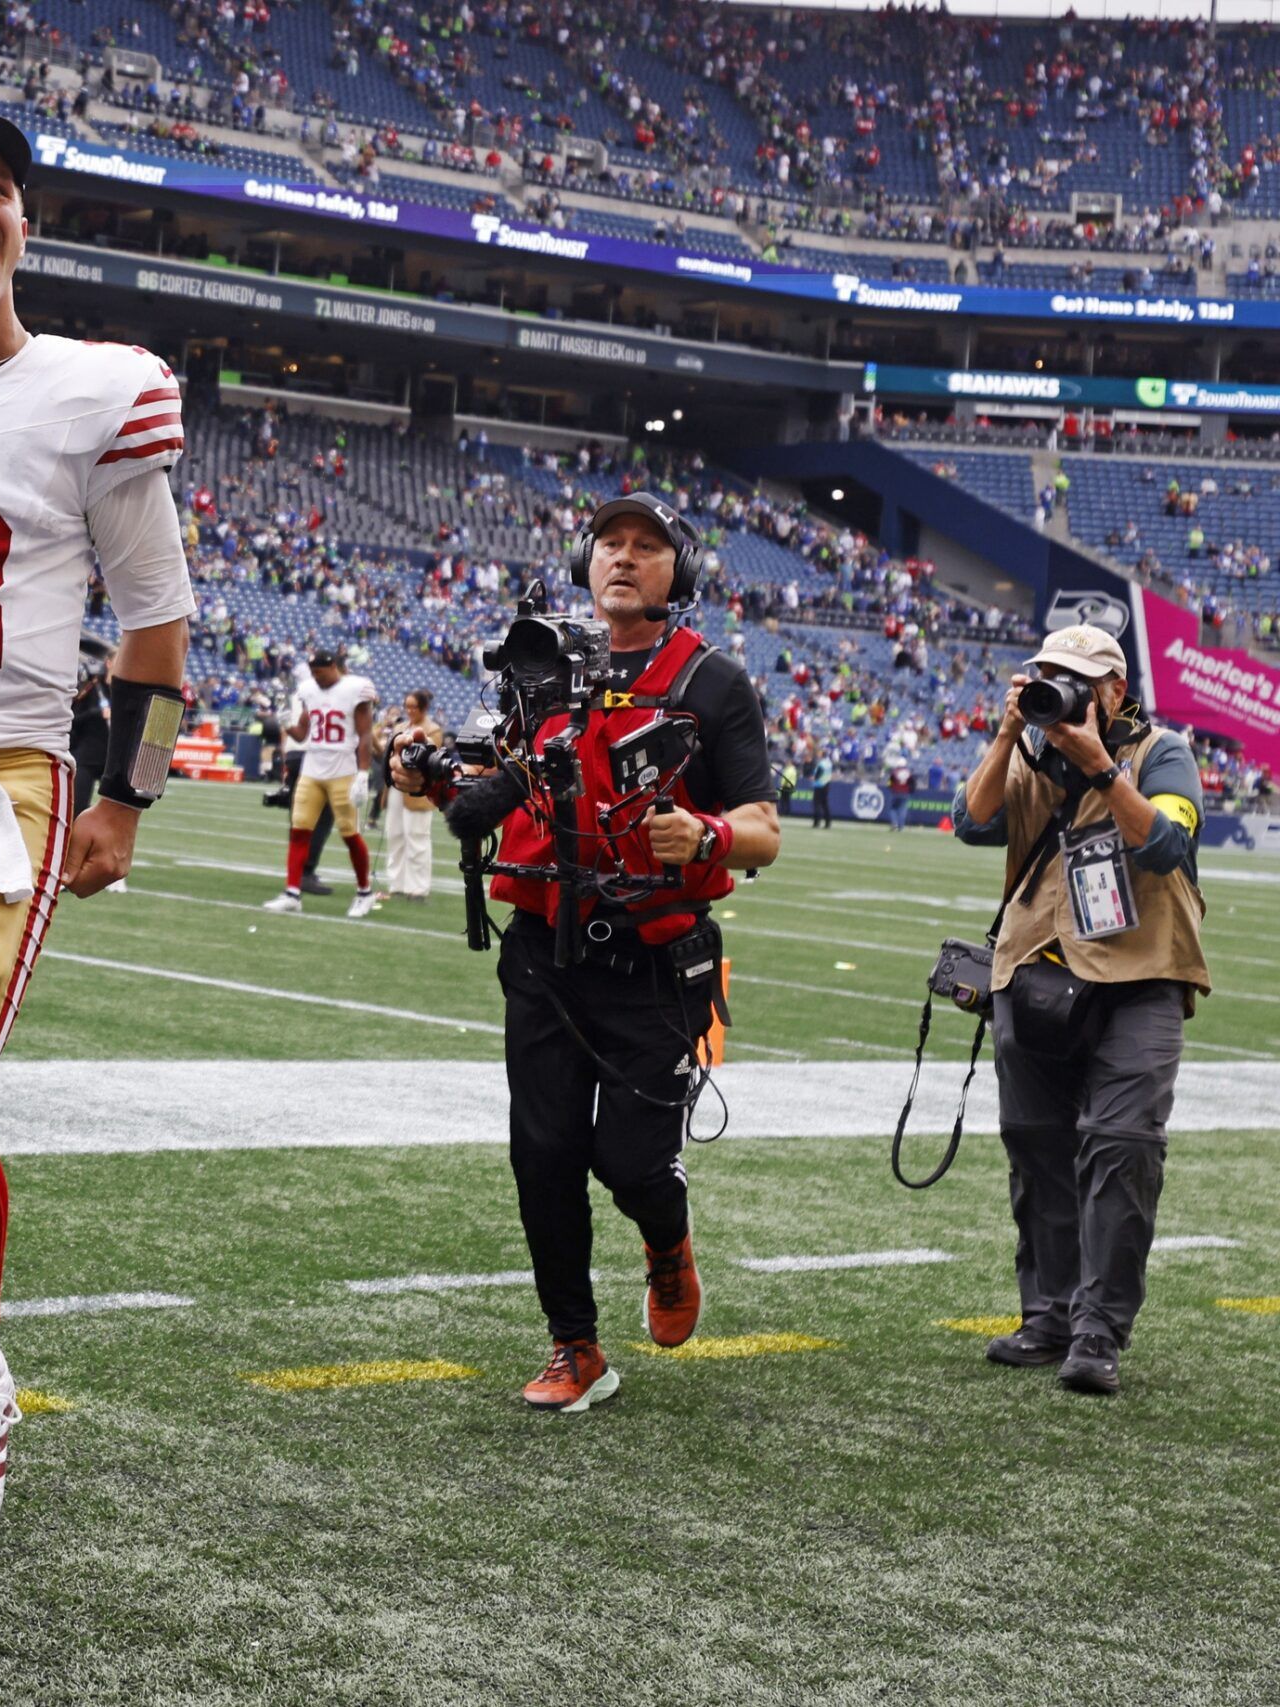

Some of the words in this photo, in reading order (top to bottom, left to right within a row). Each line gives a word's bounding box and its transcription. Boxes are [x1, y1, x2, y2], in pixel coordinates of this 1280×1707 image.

[244, 179, 272, 199] Get
[273, 184, 316, 208] Home
[316, 192, 366, 220] Safely,
[16, 253, 41, 272] UCK
[43, 256, 77, 278] KNOX
[676, 256, 752, 283] soundtransit.org
[136, 270, 159, 291] 96
[159, 275, 201, 298] CORTEZ
[204, 281, 256, 305] KENNEDY
[333, 300, 376, 323] WALTER
[376, 308, 411, 329] JONES
[1050, 295, 1083, 313] Get
[1084, 297, 1134, 316] Home
[1135, 299, 1194, 322] Safely,
[529, 330, 560, 350] MATT
[561, 335, 625, 360] HASSELBECK
[947, 372, 1060, 398] SEAHAWKS
[1164, 637, 1274, 700] America's
[1179, 667, 1232, 702] Mobile
[1231, 690, 1280, 726] Netwo
[309, 709, 346, 744] 36
[856, 791, 881, 810] 50
